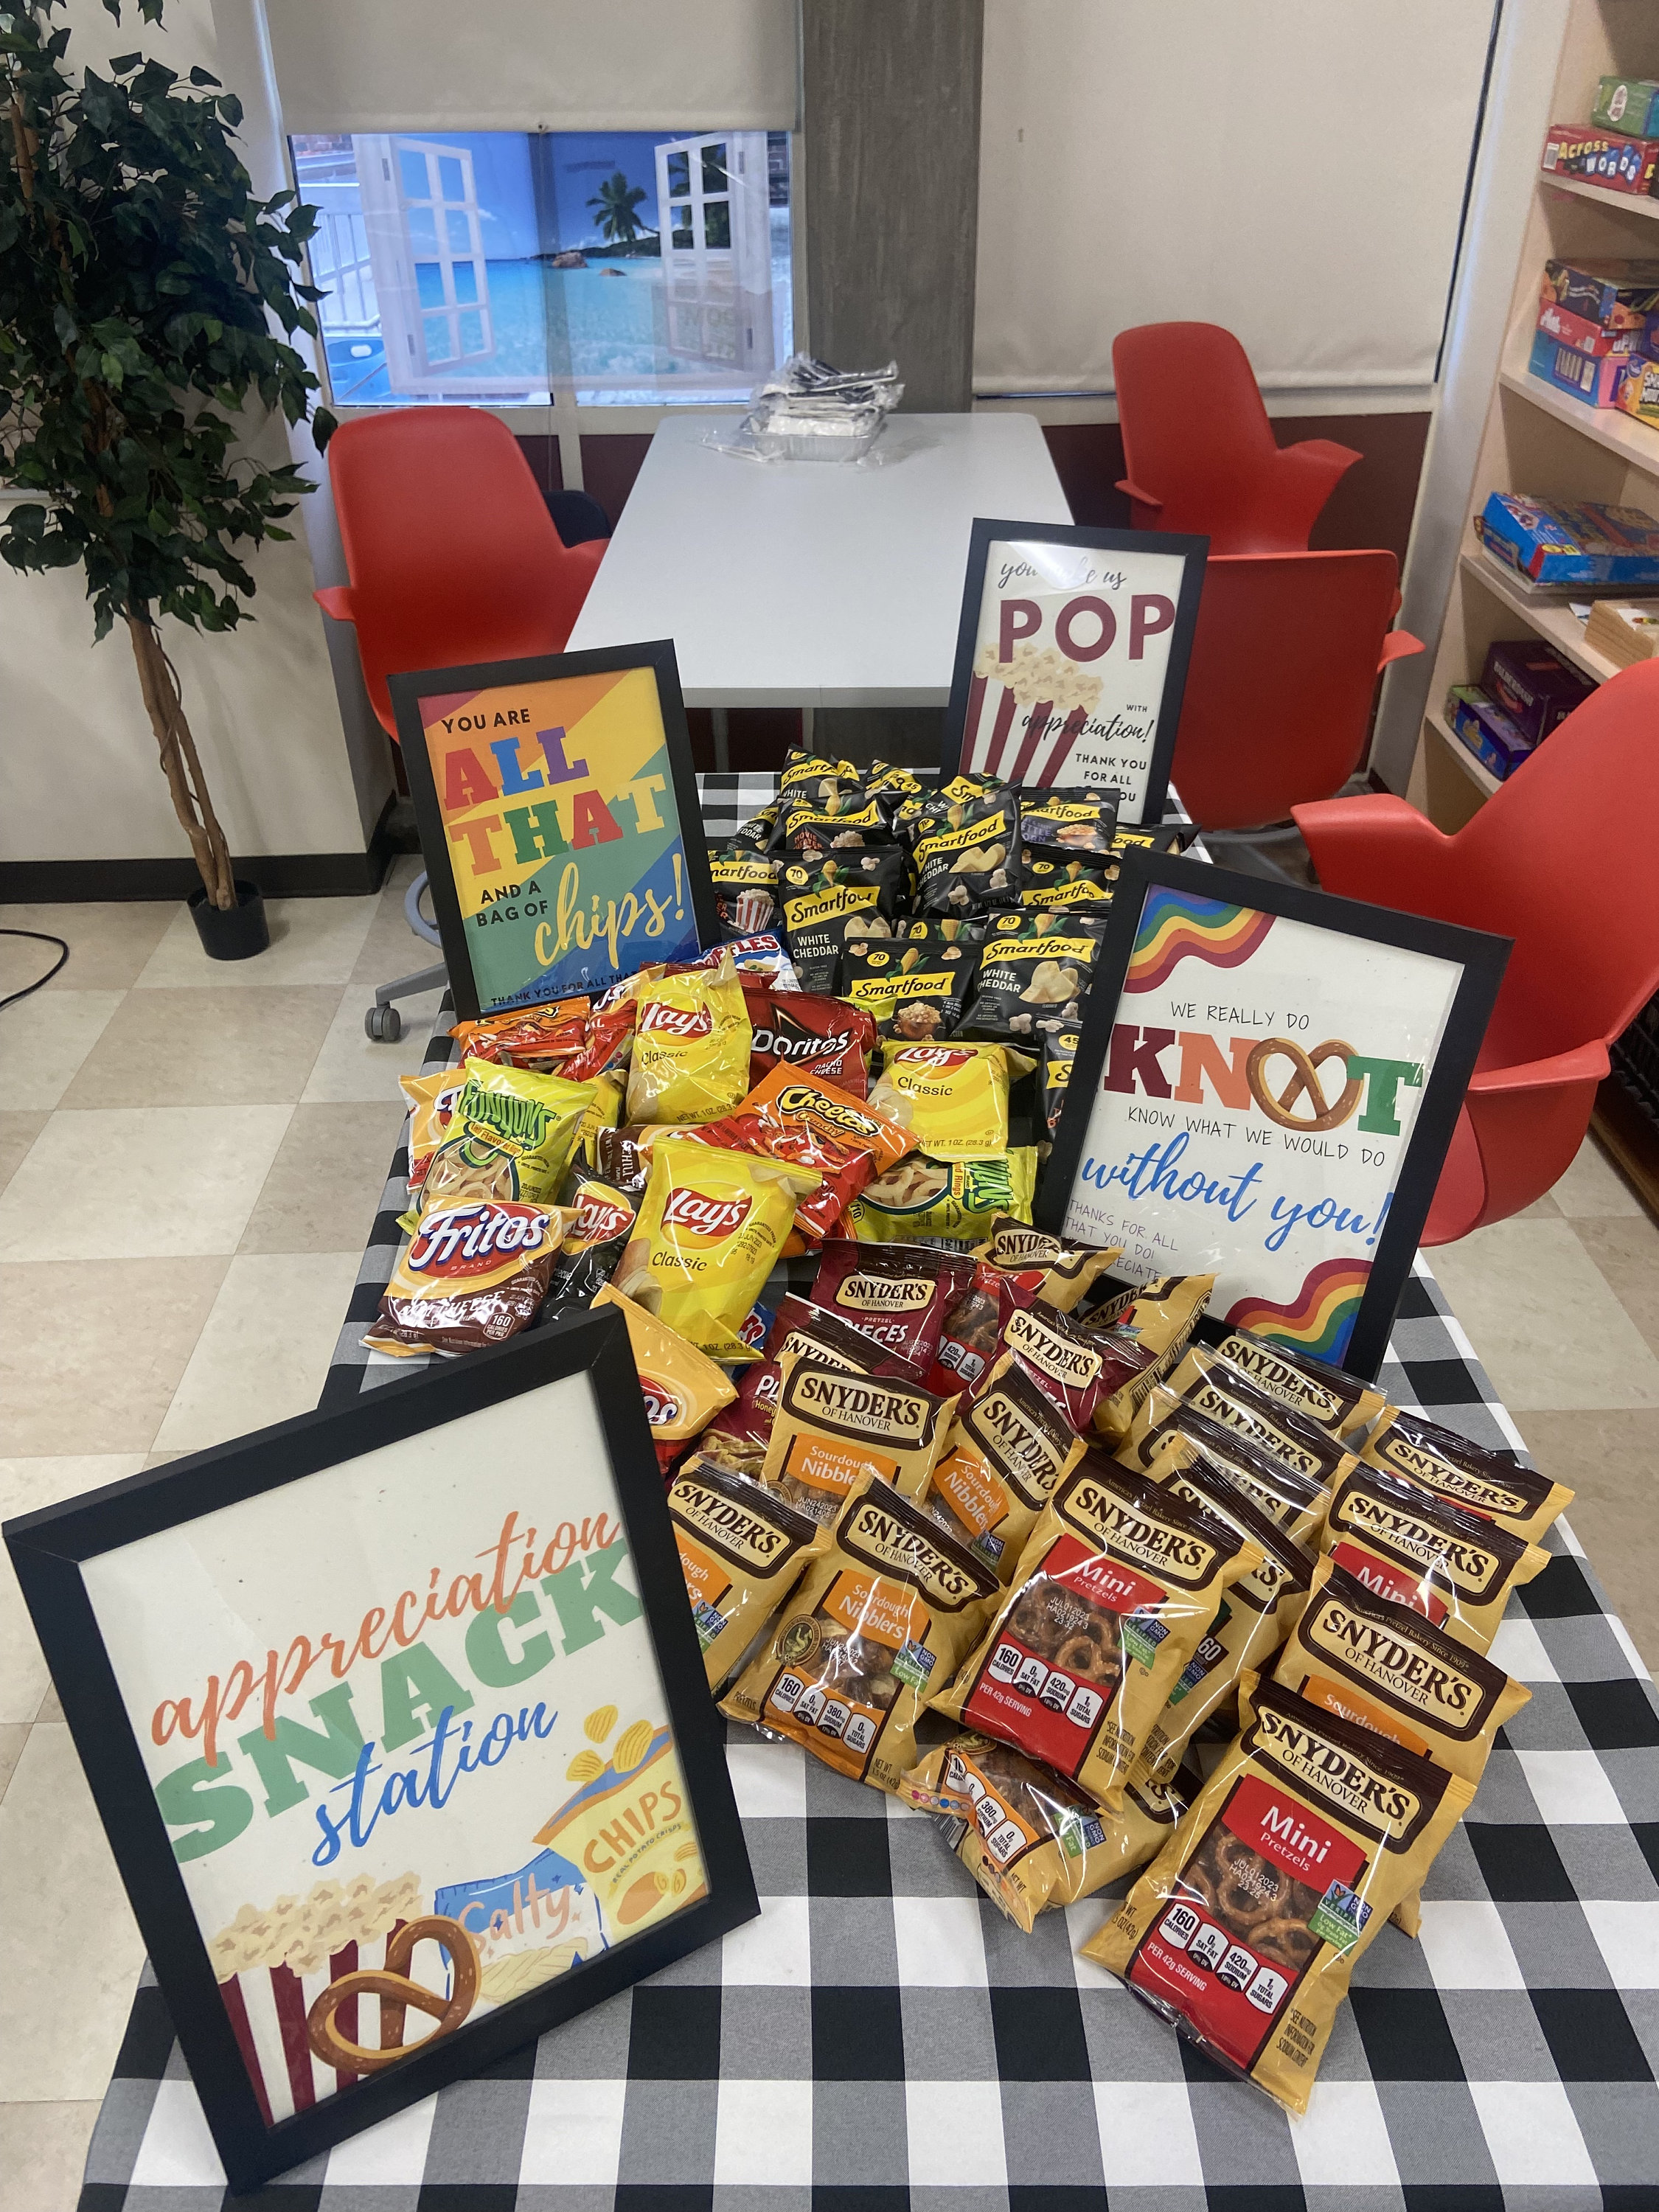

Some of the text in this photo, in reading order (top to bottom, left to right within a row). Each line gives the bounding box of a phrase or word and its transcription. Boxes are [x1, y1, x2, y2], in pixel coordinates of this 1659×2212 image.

[1102, 570, 1127, 591] us
[999, 594, 1175, 663] POP
[1127, 704, 1147, 712] WITH
[442, 709, 531, 734] YOU ARE
[1022, 714, 1155, 742] appreciation!
[444, 726, 590, 810] ALL
[1076, 753, 1147, 770] THANK YOU
[1084, 771, 1132, 785] FOR ALL
[1119, 791, 1136, 802] OU
[448, 773, 667, 876] THAT
[788, 810, 871, 829] Smartfood
[919, 818, 998, 863] Smartfood
[790, 869, 803, 878] 70
[480, 880, 542, 905] AND A
[476, 900, 549, 928] BAG OF
[535, 852, 685, 970] chips!
[1002, 917, 1015, 925] 70
[793, 945, 838, 959] CHEDDAR
[797, 934, 830, 947] WHITE
[986, 939, 1086, 961] Smartfood
[874, 953, 886, 961] 70
[855, 975, 947, 998] Smartfood
[978, 978, 1021, 993] CHEDDAR
[982, 969, 1017, 982] WHITE
[491, 991, 531, 1006] THANK
[535, 986, 560, 998] YOU
[562, 981, 584, 992] FOR
[587, 976, 607, 987] ALL
[641, 1003, 714, 1032] Lay's
[1171, 1001, 1310, 1030] WE REALLY DO
[751, 1029, 849, 1056] Doritos
[641, 1050, 688, 1065] Classic
[815, 1059, 842, 1070] NACHO
[897, 1046, 973, 1066] Lay's
[810, 1066, 843, 1075] CHEESE
[897, 1077, 953, 1096] Classic
[778, 1087, 883, 1136] Cheetos
[796, 1112, 845, 1136] Crunchy
[1127, 1107, 1385, 1166] KNOW WHAT WE WOULD DO
[952, 1175, 963, 1196] Rings
[1081, 1131, 1395, 1252] without you!
[664, 1189, 749, 1236] Lay's
[1070, 1199, 1178, 1251] THANKS FOR ALL
[408, 1204, 550, 1271] Fritos
[1065, 1217, 1155, 1260] THAT YOU DO!
[451, 1259, 493, 1271] BRAND
[652, 1251, 708, 1272] Classic
[844, 1281, 926, 1301] SNYDER'S
[871, 1300, 903, 1308] HANOVER
[493, 1315, 511, 1326] 160
[1010, 1316, 1094, 1379] SNYDER'S
[1022, 1343, 1033, 1354] OF
[1221, 1340, 1338, 1410] SNYDER'S
[1254, 1374, 1302, 1406] HANOVER
[800, 1377, 921, 1428] SNYDER'S
[821, 1405, 891, 1431] OF HANOVER
[984, 1399, 1059, 1491] SNYDER'S
[992, 1434, 1005, 1450] OF
[1394, 1444, 1520, 1509] SNYDER'S
[1413, 1467, 1486, 1503] OF HANOVER
[674, 1484, 782, 1554] SNYDER'S
[686, 1506, 745, 1550] OF HANOVER
[1076, 1487, 1206, 1567] SNYDER'S
[1371, 1523, 1388, 1536] OF
[1093, 1522, 1169, 1566] OF HANOVER
[1348, 1496, 1489, 1577] SNYDER'S
[858, 1510, 970, 1596] SNYDER'S
[874, 1542, 933, 1583] OF HANOVER
[1074, 1562, 1136, 1597] Mini
[1074, 1576, 1118, 1602] Pretzels
[852, 1584, 910, 1618] Sourdough
[839, 1595, 905, 1639] Nibblers
[1154, 1621, 1169, 1635] NON
[151, 1511, 621, 1768] appreciation
[1150, 1627, 1166, 1640] GMO
[1385, 1615, 1449, 1658] Pretzel Bakery Since
[992, 1660, 1015, 1675] CALORIES
[998, 1647, 1019, 1666] 160
[1323, 1609, 1472, 1710] SNYDER'S
[1020, 1672, 1040, 1687] SAT FAT
[1186, 1666, 1202, 1681] GMO
[1190, 1662, 1206, 1677] NON
[1344, 1646, 1429, 1707] OF HANOVER
[774, 1688, 796, 1704] CALORIES
[779, 1676, 801, 1696] 160
[1046, 1687, 1067, 1702] SODIUM
[1050, 1677, 1070, 1695] 420mg
[155, 1537, 644, 1864] SNACK
[980, 1683, 1032, 1717] PER 42g SERVING
[1076, 1703, 1091, 1716] TOTAL
[824, 1715, 843, 1729] SODIUM
[1070, 1709, 1091, 1724] SUGARS
[846, 1735, 866, 1749] SUGARS
[851, 1730, 866, 1742] TOTAL
[1262, 1712, 1411, 1820] SNYDER'S
[311, 1702, 559, 1867] station
[1281, 1750, 1368, 1814] OF HANOVER
[583, 1781, 682, 1874] CHIPS
[1088, 1825, 1101, 1844] GMO
[1093, 1821, 1106, 1843] NON
[1260, 1806, 1332, 1864] Mini
[611, 1823, 682, 1884] REAL POTATO CRISPS
[990, 1837, 1009, 1858] SUGARS
[996, 1834, 1012, 1853] TOTAL
[1260, 1832, 1311, 1871] Pretzels
[1234, 1858, 1279, 1892] JUL012023
[1353, 1896, 1371, 1913] NON
[1164, 1919, 1189, 1941] CALORIES
[1171, 1907, 1196, 1931] 160
[1320, 1913, 1335, 1929] Low
[1196, 1939, 1219, 1959] SAT FAT
[1147, 1941, 1207, 1992] PER 42g SERVING
[1224, 1962, 1248, 1980] SODIUM
[1229, 1952, 1251, 1975] 420mg
[1249, 1989, 1273, 2008] SUGARS
[1257, 1983, 1273, 2000] TOTAL
